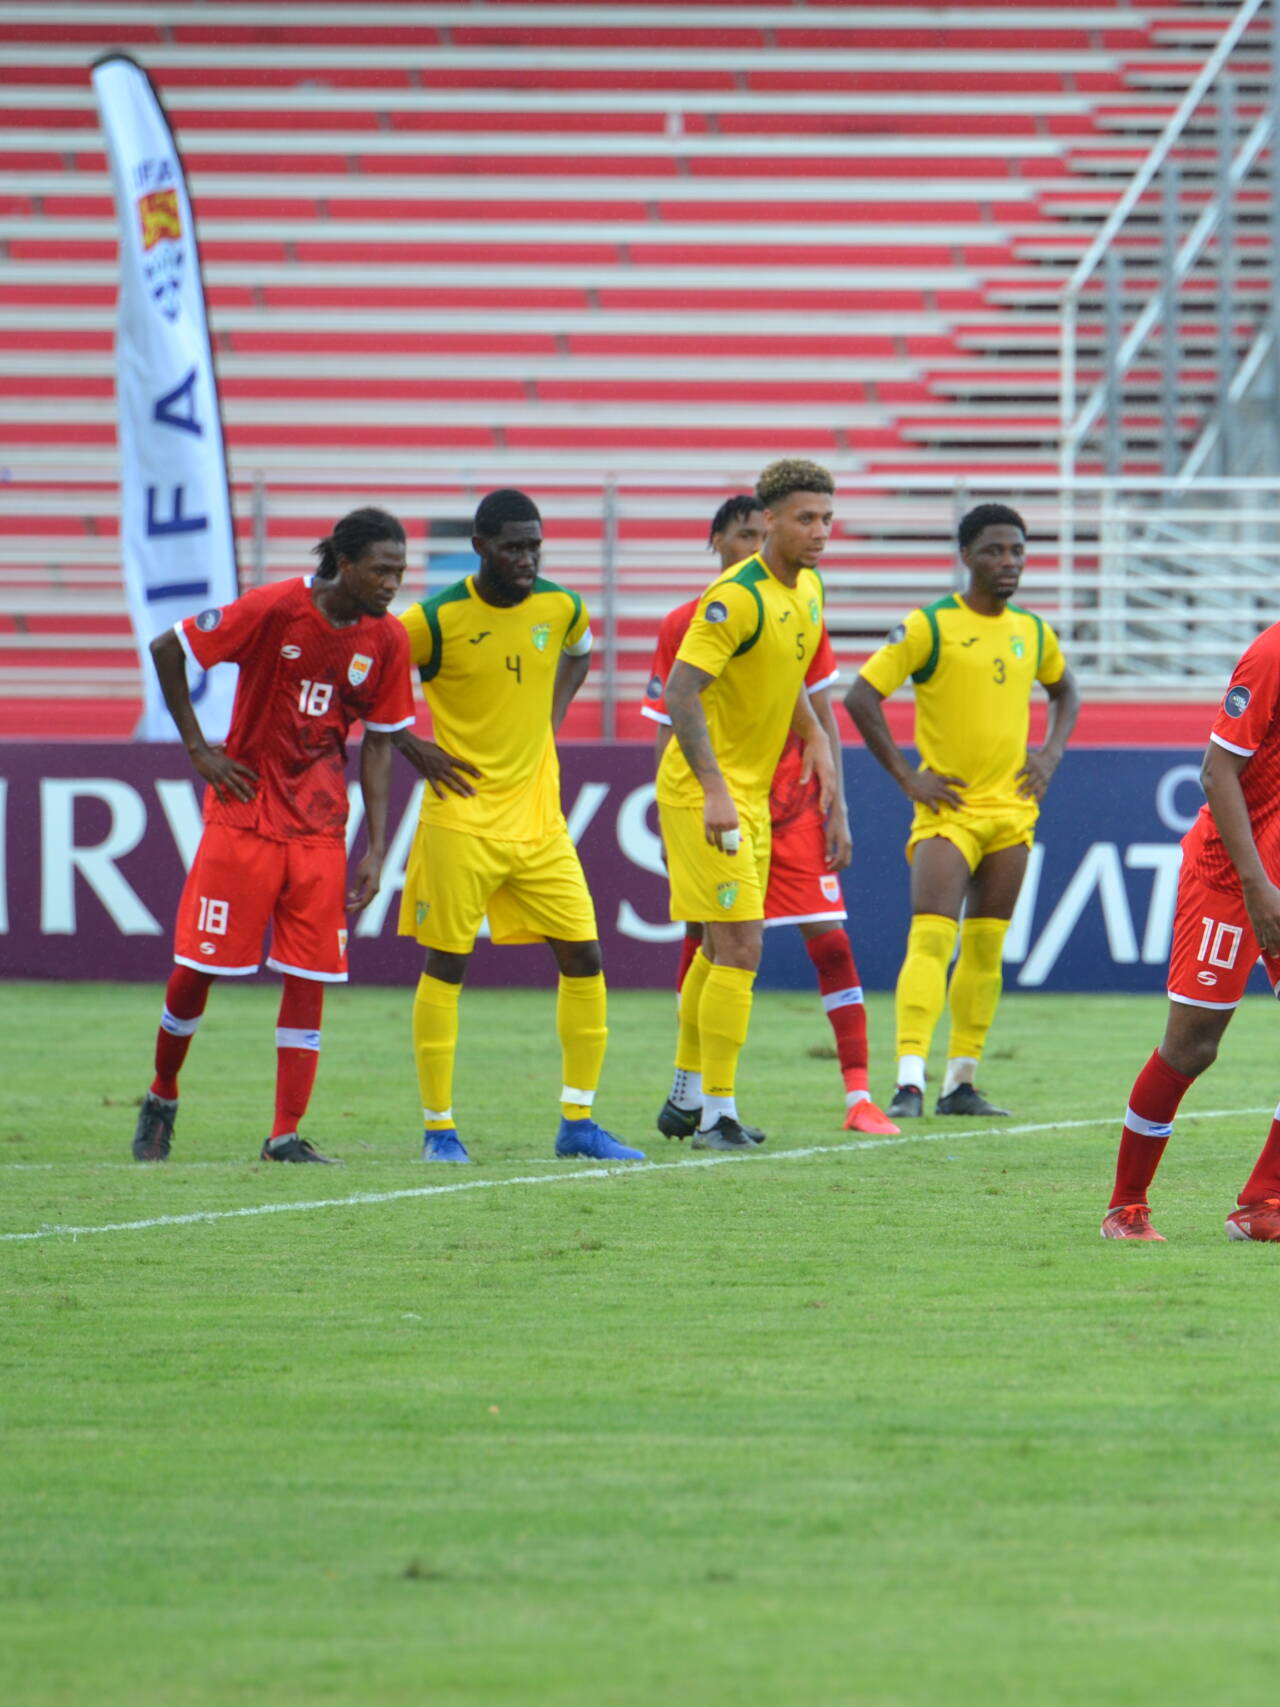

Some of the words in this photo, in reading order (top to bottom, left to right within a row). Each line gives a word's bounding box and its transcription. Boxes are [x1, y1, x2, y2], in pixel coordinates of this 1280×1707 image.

[146, 366, 209, 712] IFA
[796, 633, 805, 660] 5
[506, 655, 522, 684] 4
[993, 658, 1006, 684] 3
[298, 680, 333, 717] 18
[198, 896, 230, 936] 18
[1197, 916, 1243, 970] 10
